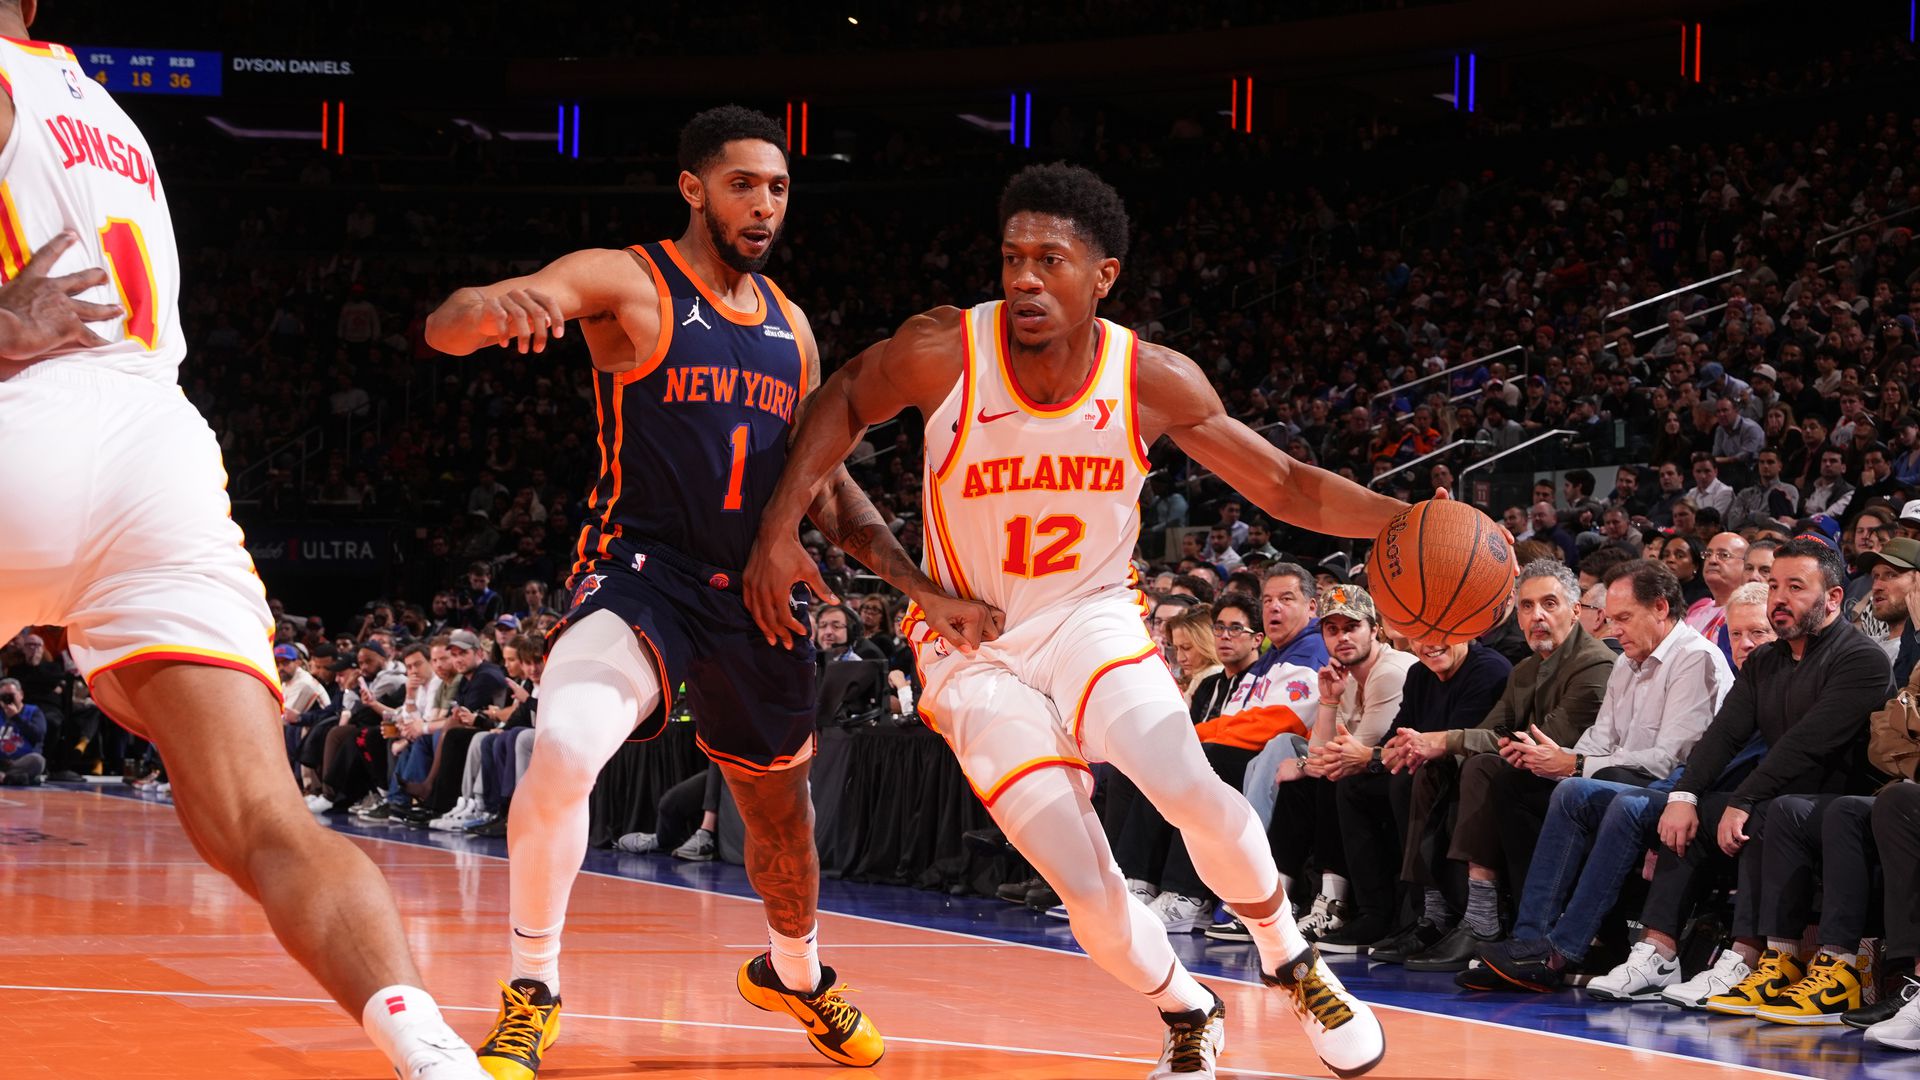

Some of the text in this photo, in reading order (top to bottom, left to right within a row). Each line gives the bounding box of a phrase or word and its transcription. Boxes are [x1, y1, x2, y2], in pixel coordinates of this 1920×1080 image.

[89, 53, 195, 68] STL AST REB
[95, 70, 191, 89] 4 18 36
[233, 57, 286, 72] DYSON
[45, 114, 156, 202] JOHNSON
[98, 214, 158, 352] 1
[663, 366, 797, 425] NEW YORK
[1084, 413, 1096, 421] the
[721, 422, 750, 512] 1
[962, 454, 1125, 499] ATLANTA
[303, 541, 374, 559] ULTRA
[1002, 513, 1087, 580] 12
